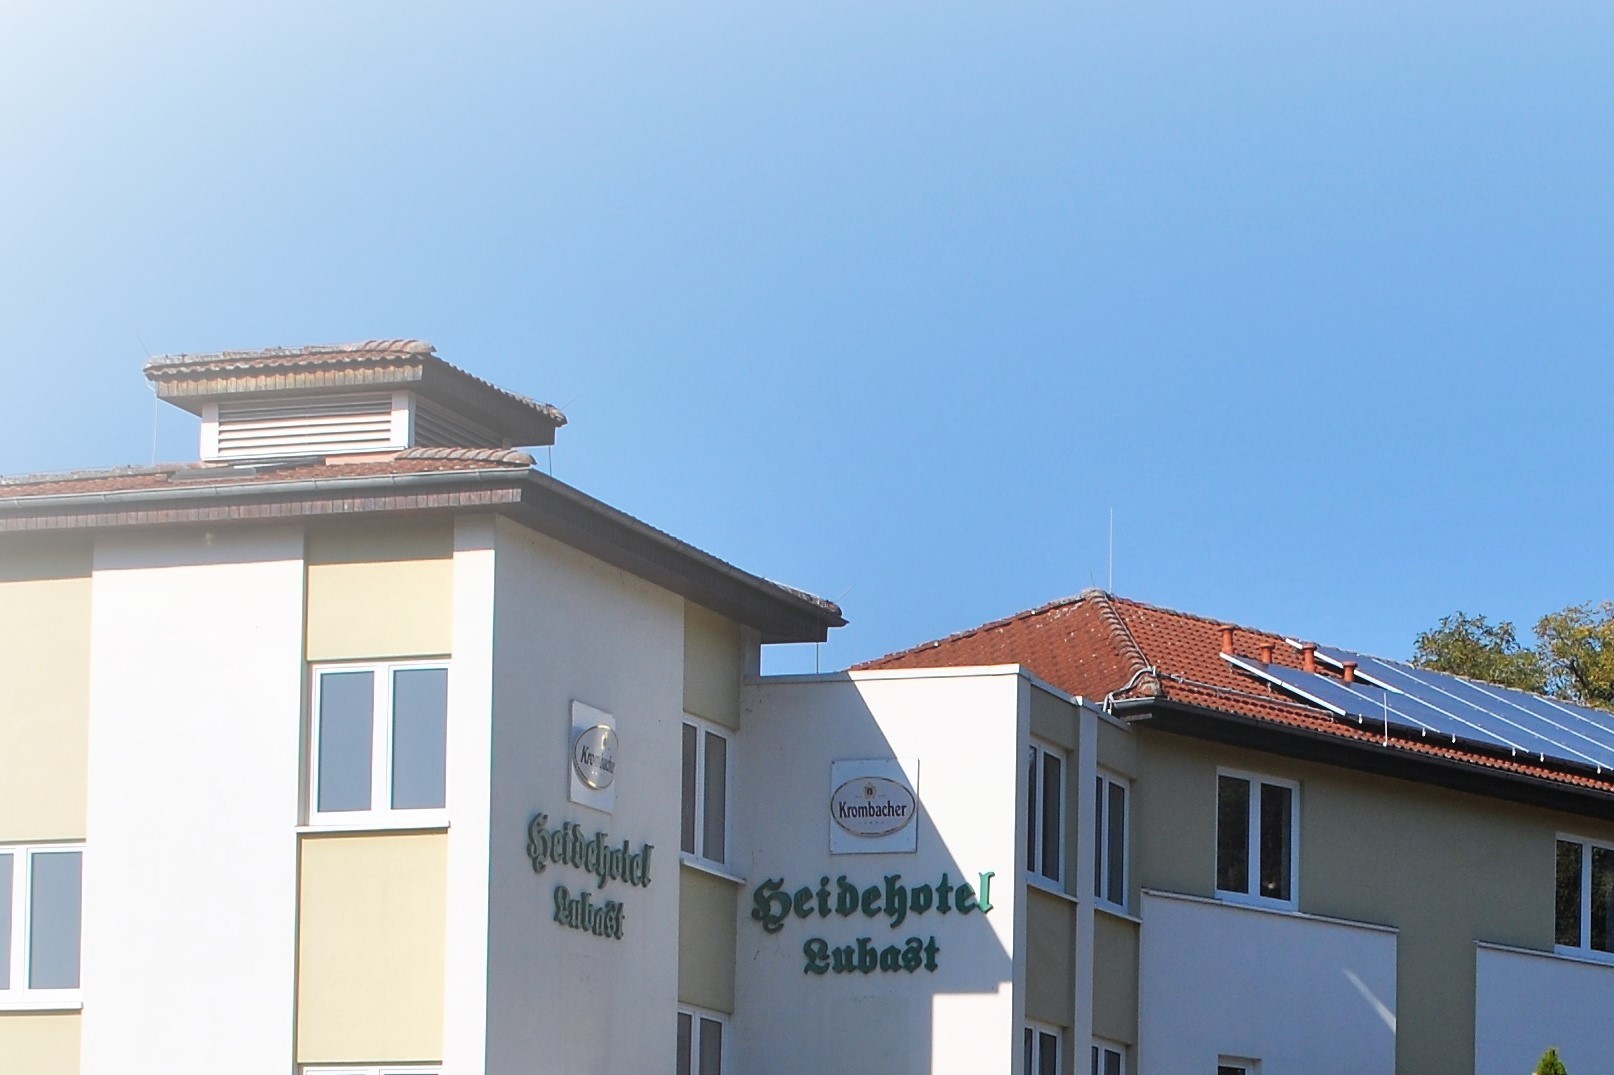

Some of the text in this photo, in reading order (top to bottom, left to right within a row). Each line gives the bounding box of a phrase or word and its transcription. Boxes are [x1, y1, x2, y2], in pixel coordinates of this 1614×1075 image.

[838, 800, 907, 819] Krombacher
[526, 812, 655, 889] Heidehotel
[553, 885, 625, 941] Lubast
[751, 871, 996, 934] Heidehotel
[803, 935, 940, 974] Lubast
